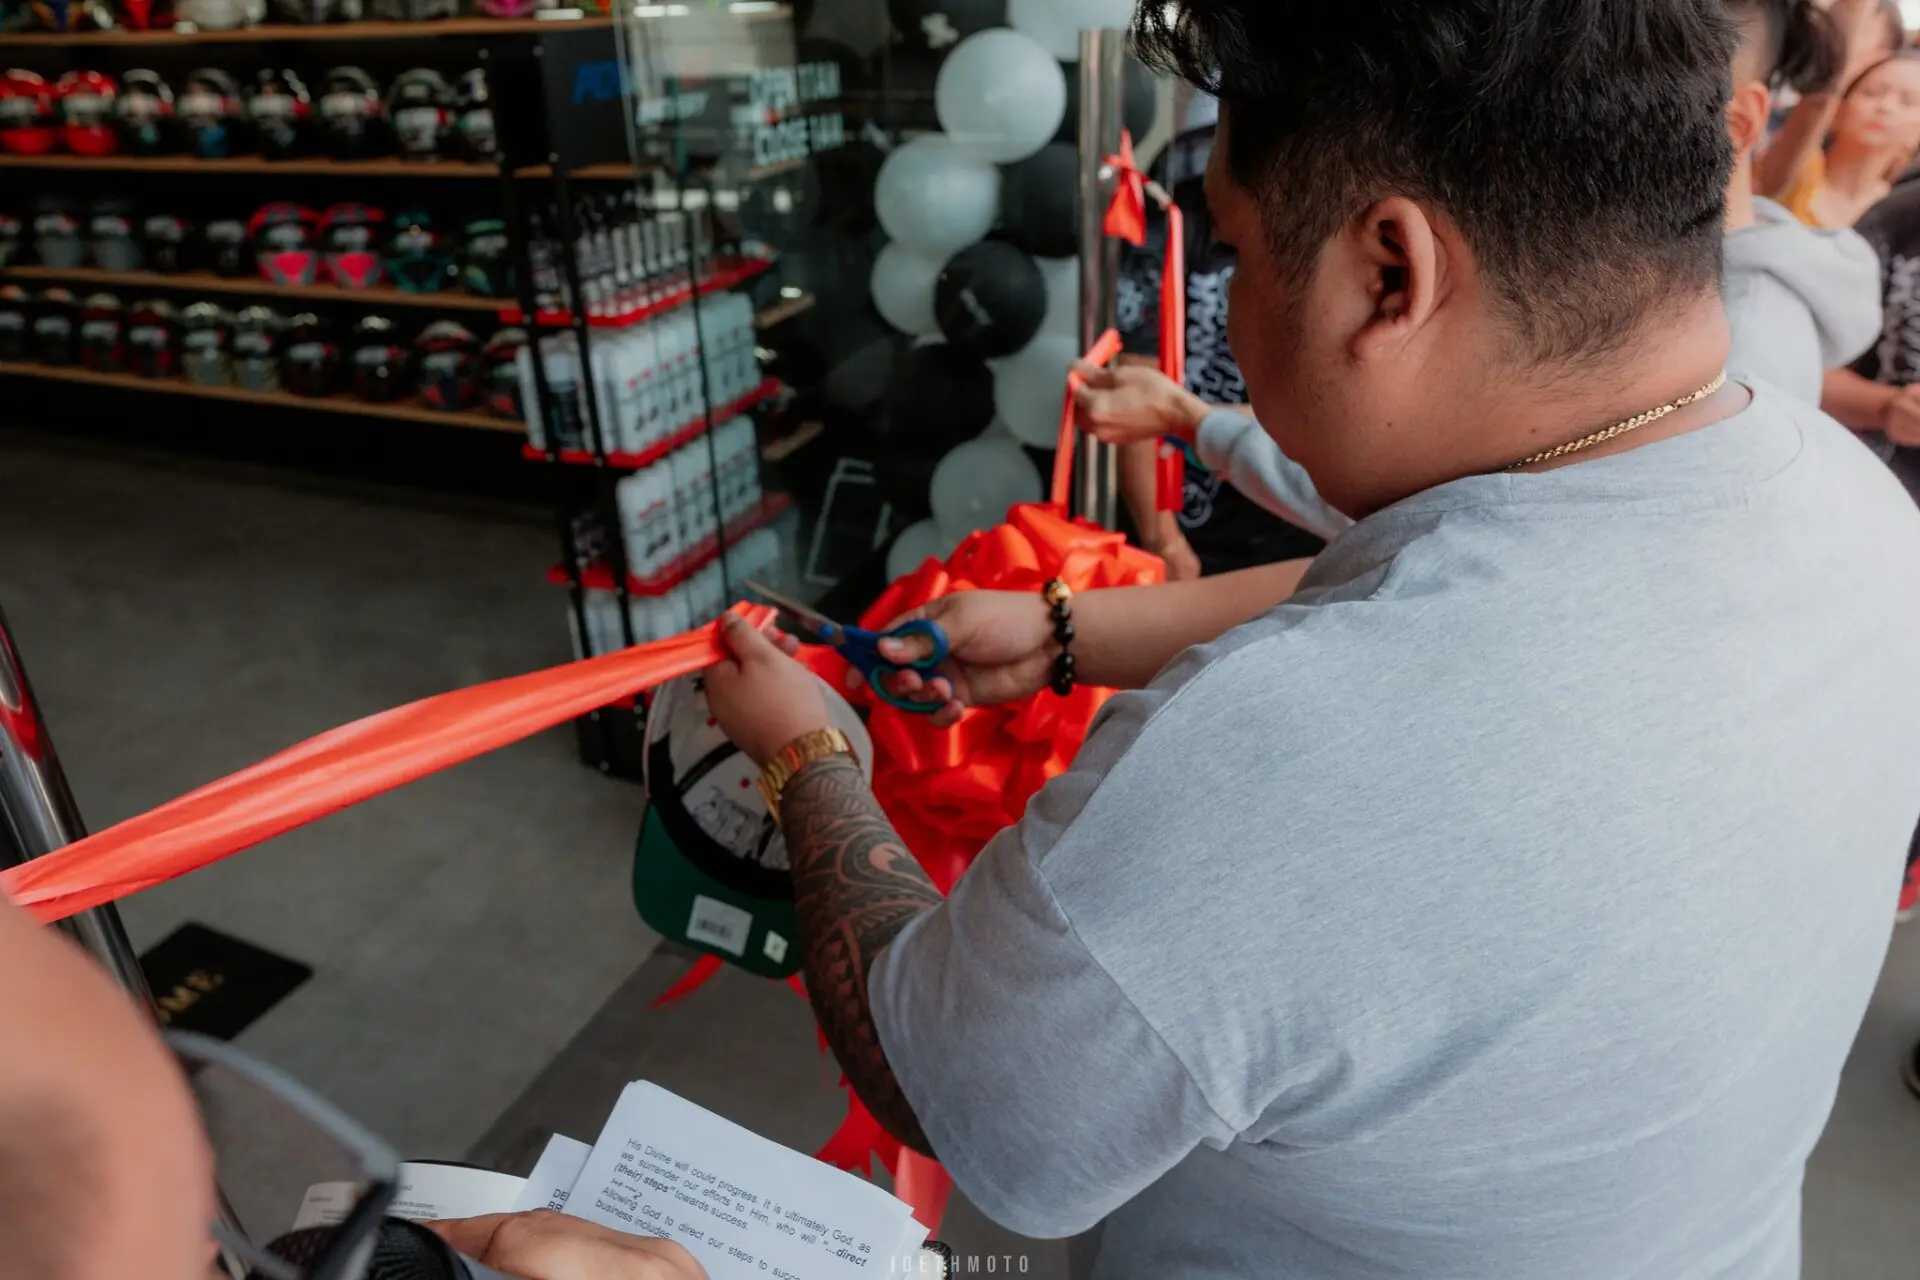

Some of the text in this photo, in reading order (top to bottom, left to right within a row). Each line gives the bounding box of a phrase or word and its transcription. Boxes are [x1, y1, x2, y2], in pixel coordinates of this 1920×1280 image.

[595, 1199, 633, 1223] business
[602, 1186, 638, 1211] Allowing
[641, 1204, 662, 1220] God
[664, 1215, 674, 1226] to
[678, 1222, 705, 1240] direct
[707, 1236, 725, 1250] our
[727, 1246, 754, 1264] steps
[758, 1259, 768, 1270] to
[613, 1162, 644, 1182] (their)
[674, 1190, 710, 1212] towards
[621, 1152, 635, 1162] we
[638, 1159, 680, 1182] surrender
[683, 1180, 700, 1191] our
[702, 1188, 731, 1207] efforts
[736, 1202, 745, 1213] to
[776, 1220, 796, 1236] who
[801, 1233, 817, 1246] will
[627, 1138, 642, 1151] His
[644, 1145, 672, 1164] Divine
[674, 1160, 690, 1172] will
[691, 1168, 717, 1184] could
[763, 1199, 771, 1210] It
[773, 1203, 782, 1214] is
[784, 1209, 829, 1236] ultimately
[858, 1242, 872, 1254] as
